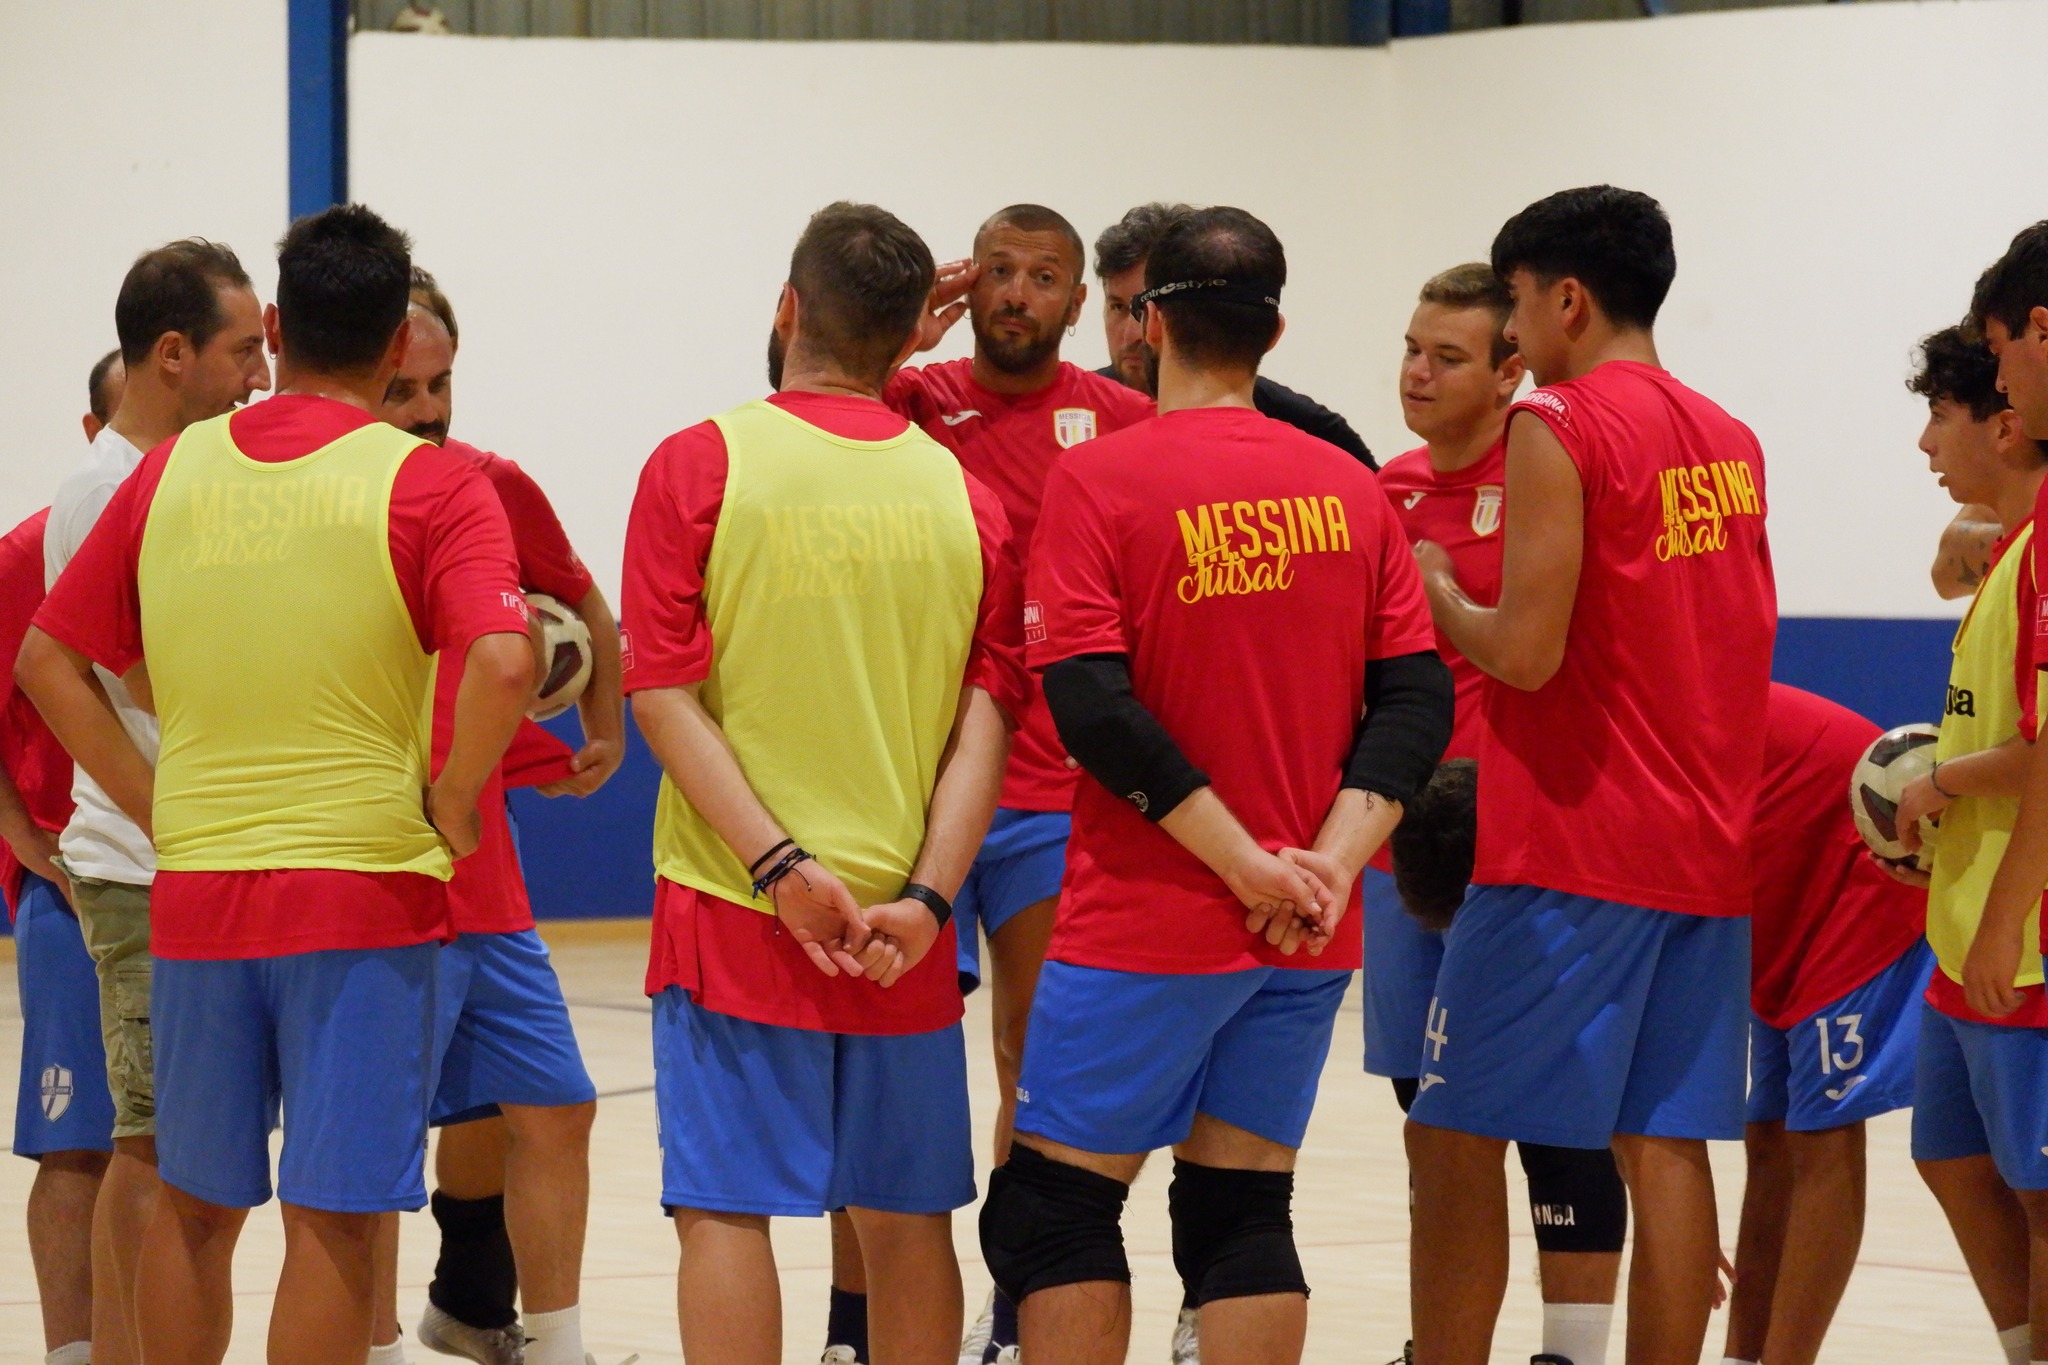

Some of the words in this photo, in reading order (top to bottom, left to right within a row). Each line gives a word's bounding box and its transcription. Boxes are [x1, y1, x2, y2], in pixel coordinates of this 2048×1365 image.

[190, 474, 368, 534] MESSINA
[763, 503, 935, 564] MESSINA
[1176, 495, 1351, 563] MESSINA
[1177, 539, 1295, 604] Futsal
[1816, 1014, 1864, 1074] 13
